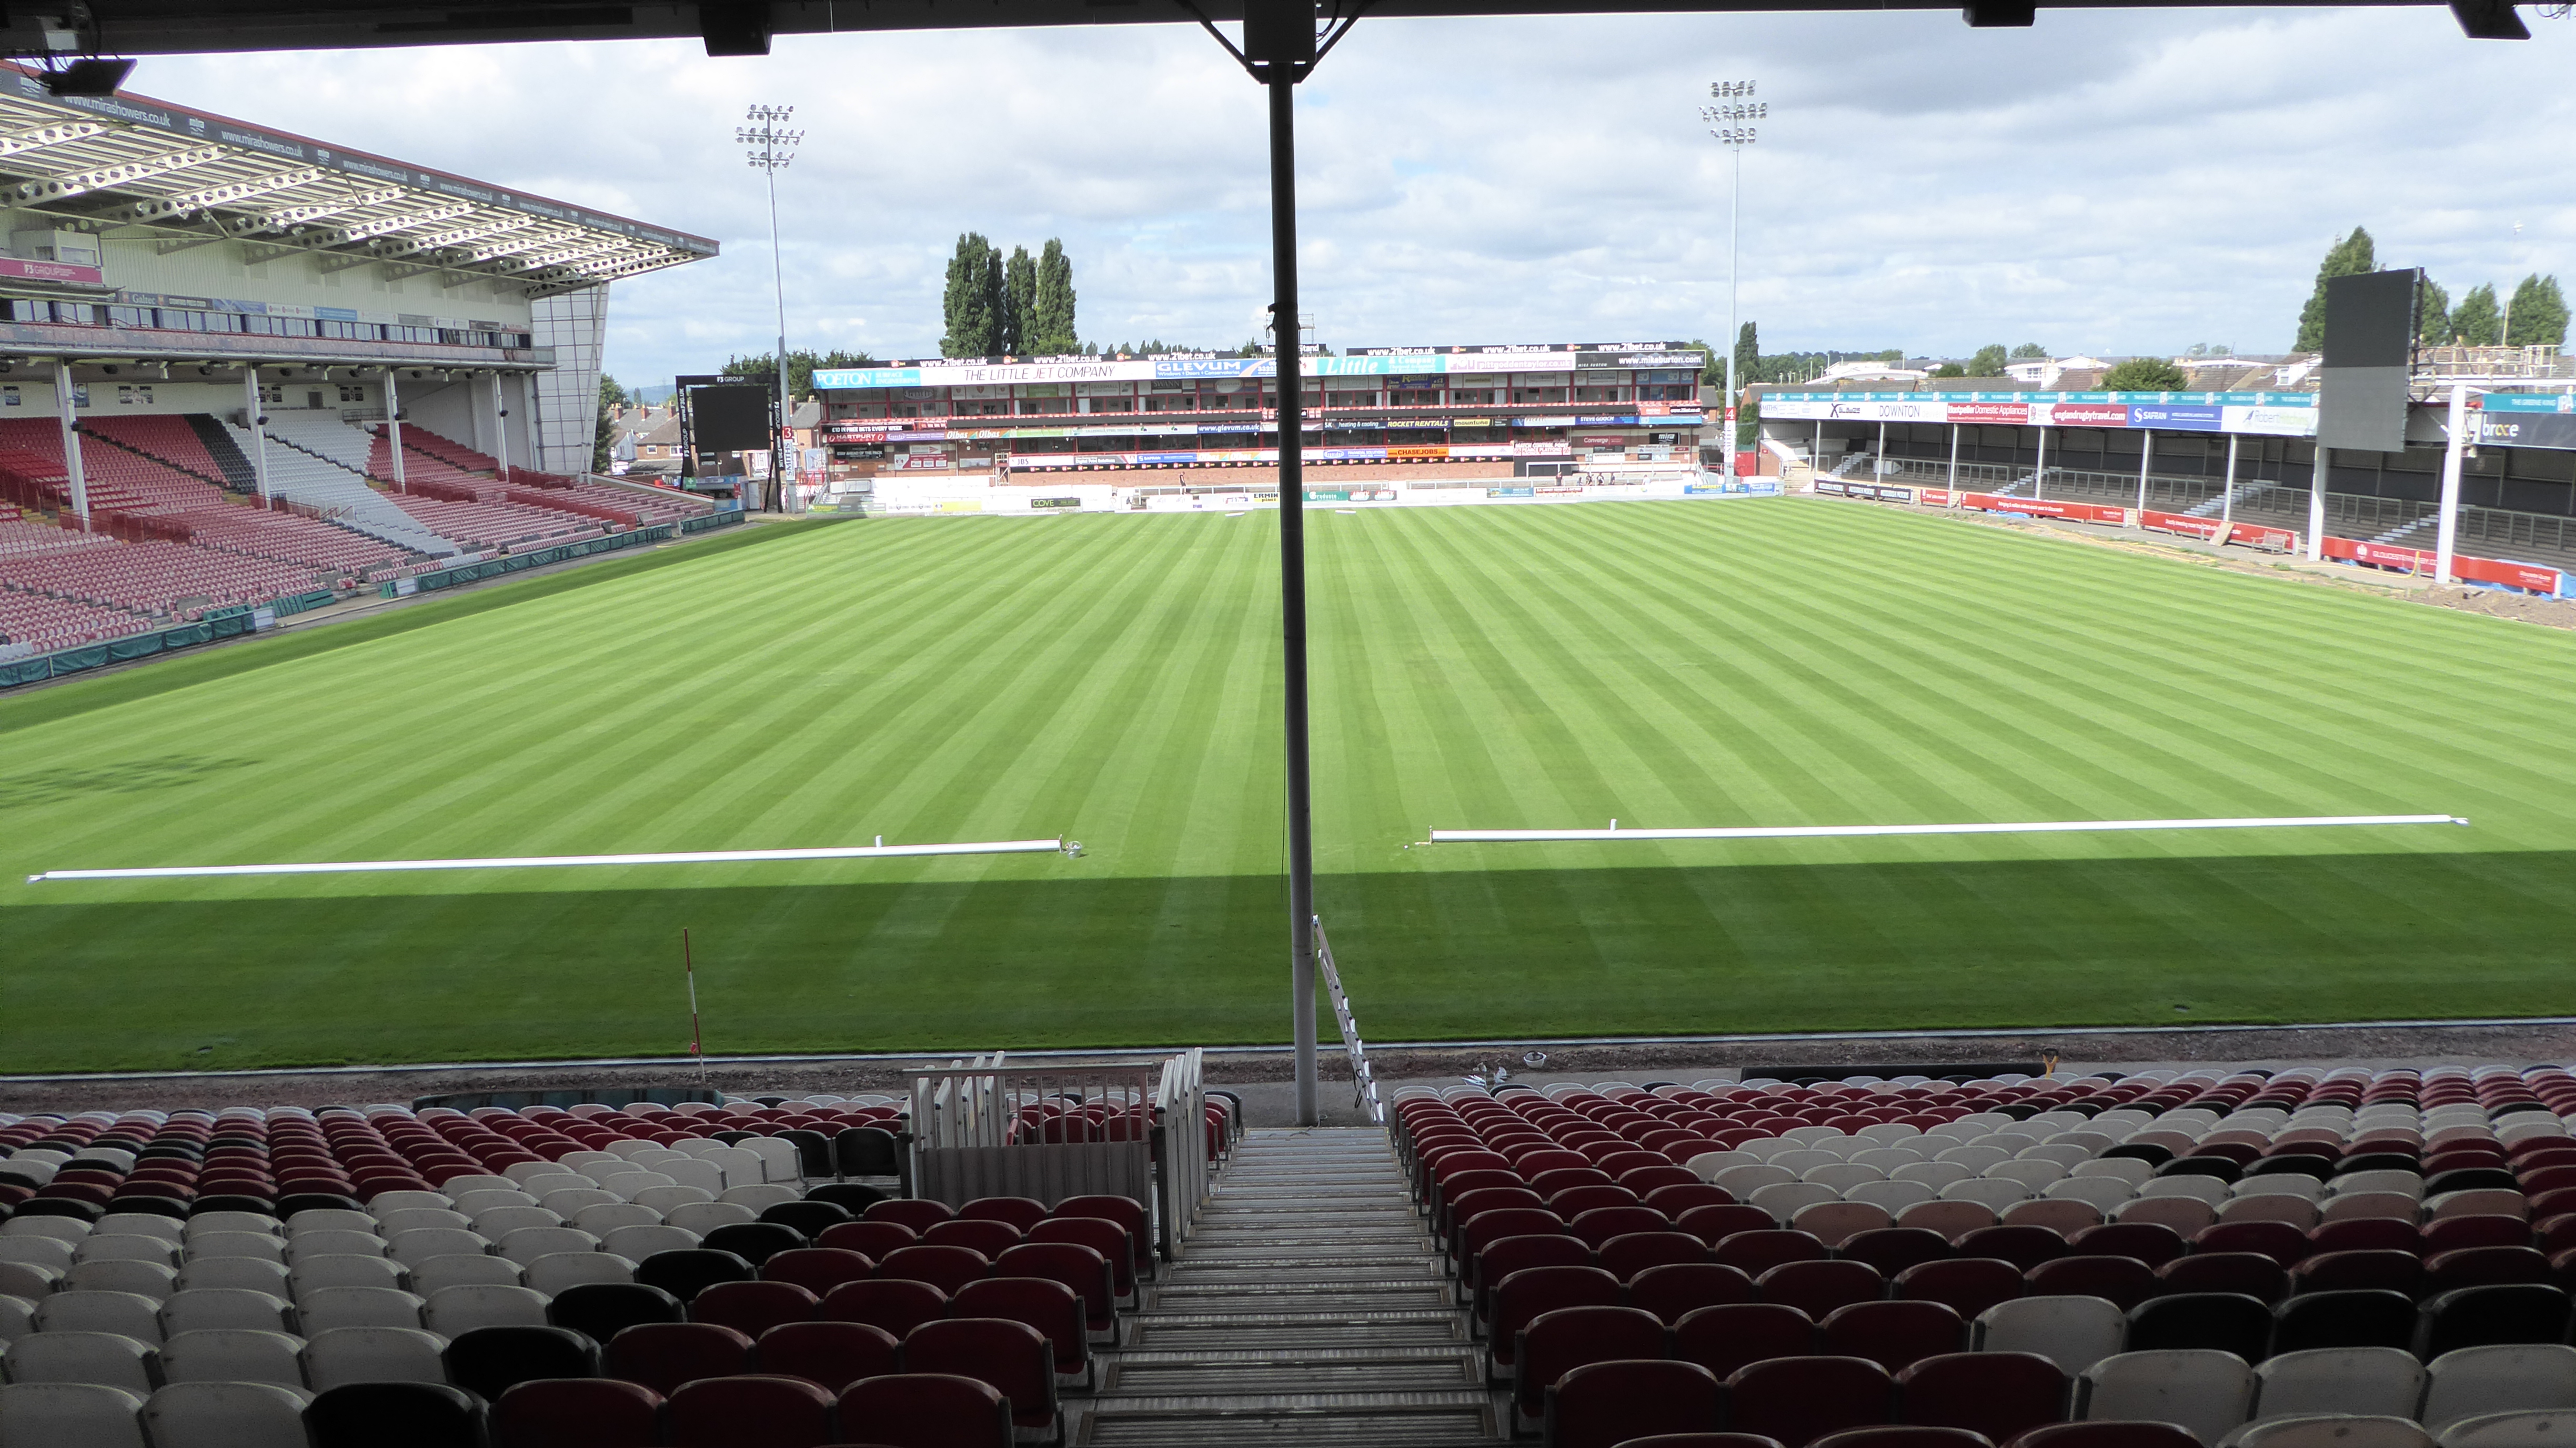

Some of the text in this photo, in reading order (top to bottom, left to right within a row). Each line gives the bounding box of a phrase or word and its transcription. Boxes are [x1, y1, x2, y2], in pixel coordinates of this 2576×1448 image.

[222, 130, 303, 157] www.mirashowers.co.uk
[343, 159, 408, 182] www.mirashowers.co.uk
[35, 266, 59, 275] GROUP
[1367, 346, 1436, 356] www.21bet.co.uk
[1482, 344, 1551, 354] www.21bet.co.uk
[1598, 342, 1666, 351] www.21bet.co.uk
[1034, 354, 1102, 364] www.21bet.co.uk
[1148, 351, 1215, 361] www.21bet.co.uk
[1398, 357, 1436, 365] Company
[1618, 355, 1701, 365] www.mikeburton.com
[920, 356, 988, 367] www.21bet.co.uk
[1157, 361, 1241, 371] GLEVUM
[1325, 357, 1378, 374] Little
[1479, 359, 1570, 369] pittgoddentaylor.co.uk
[965, 365, 1115, 381] THE LITTLE JET COMPANY
[1637, 371, 1649, 381] sd
[1667, 371, 1679, 381] sd
[1682, 371, 1693, 381] sd
[816, 373, 872, 386] POETON
[2558, 395, 2574, 411] IPA
[1726, 409, 1735, 419] 4
[1879, 405, 1920, 418] DOWNTON
[1948, 405, 1975, 416] Montpellier
[1975, 405, 1999, 415] Domestic
[1999, 406, 2028, 416] Appliances
[2054, 410, 2126, 421] englandrugbytravel.com
[2142, 411, 2167, 420] SAFRAN
[2255, 410, 2279, 424] Robert
[784, 428, 791, 438] 3
[1199, 424, 1260, 432] www.glevum.co.uk
[947, 431, 968, 439] Olbas
[979, 430, 1000, 438] Olbas
